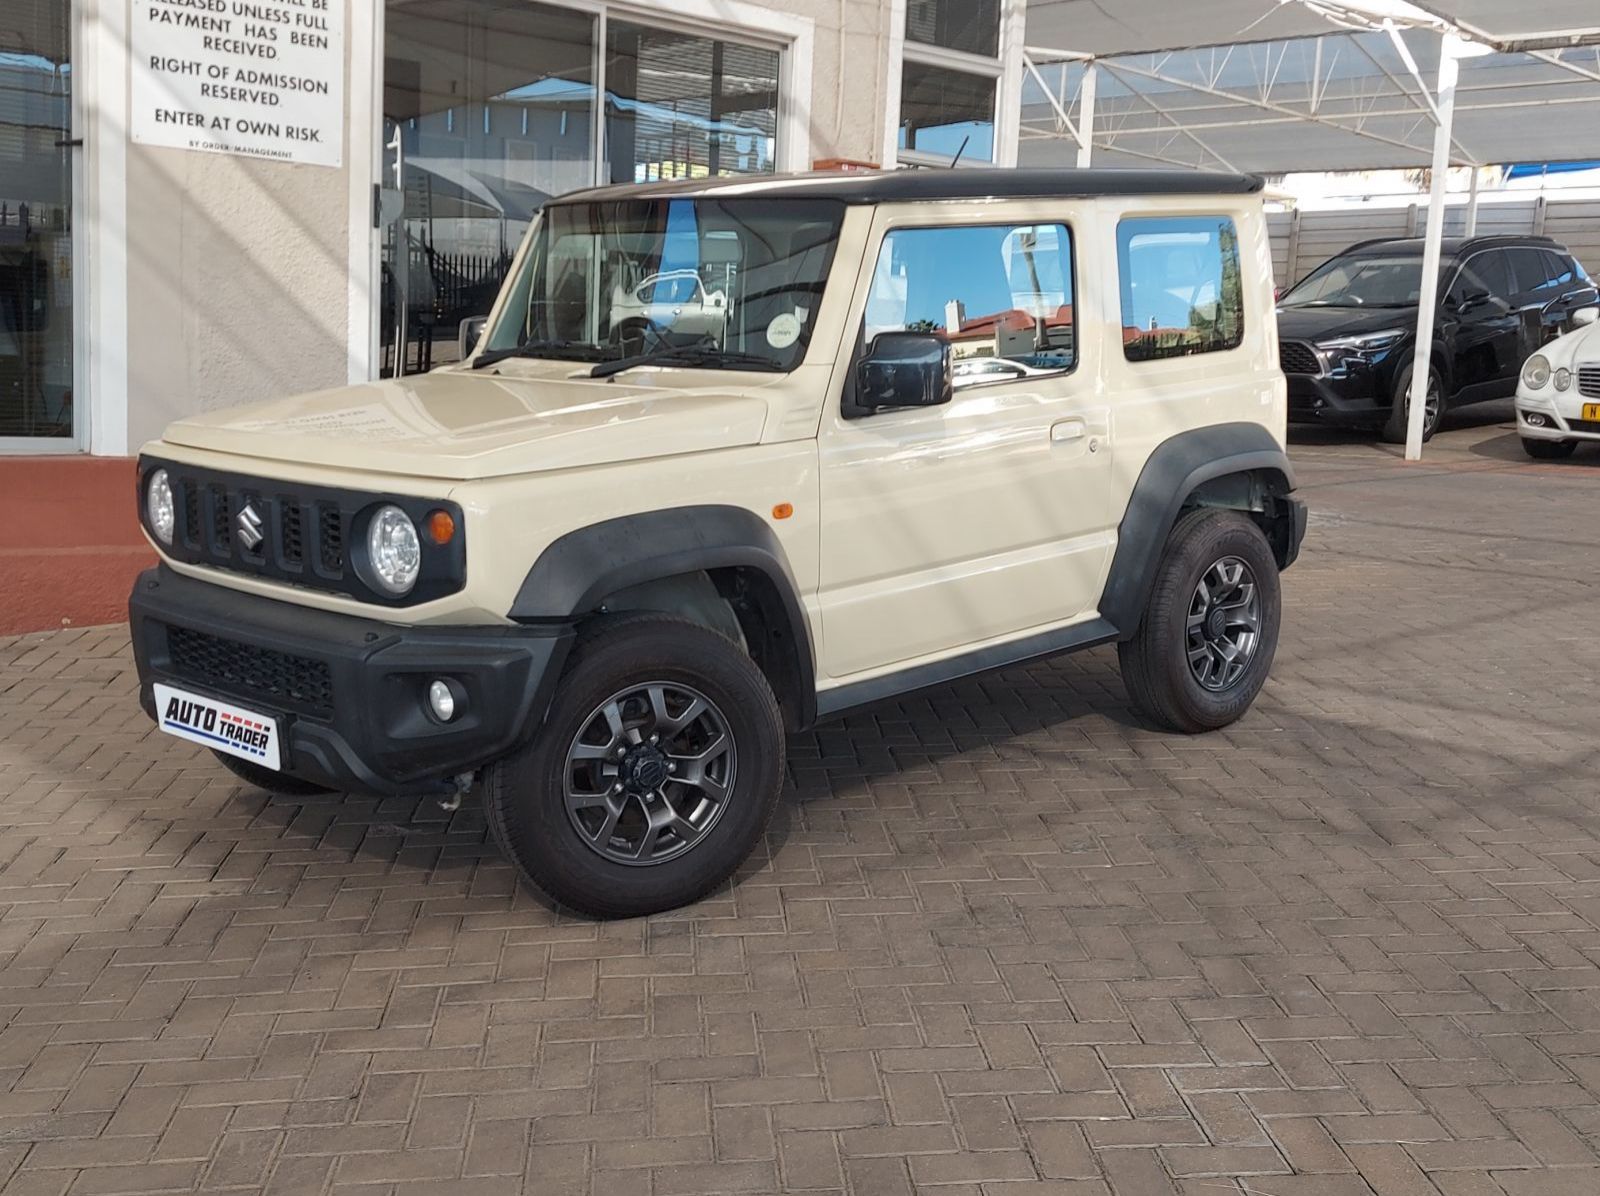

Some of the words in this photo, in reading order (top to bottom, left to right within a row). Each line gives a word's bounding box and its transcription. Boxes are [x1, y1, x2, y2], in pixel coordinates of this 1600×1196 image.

[232, 1, 290, 24] UNLESS
[296, 13, 328, 31] FULL
[312, 0, 328, 10] BE
[150, 8, 231, 33] PAYMENT
[245, 23, 277, 41] HAS
[290, 31, 328, 49] BEEN
[150, 56, 202, 76] RIGHT
[207, 65, 230, 80] OF
[235, 69, 328, 94] ADMISSION
[155, 109, 204, 128] ENTER
[211, 116, 230, 131] AT
[236, 119, 280, 137] OWN
[286, 126, 324, 144] RISK.
[234, 146, 293, 158] MANAGEMENT
[165, 697, 217, 732] AUTO
[219, 720, 269, 750] TRADER
